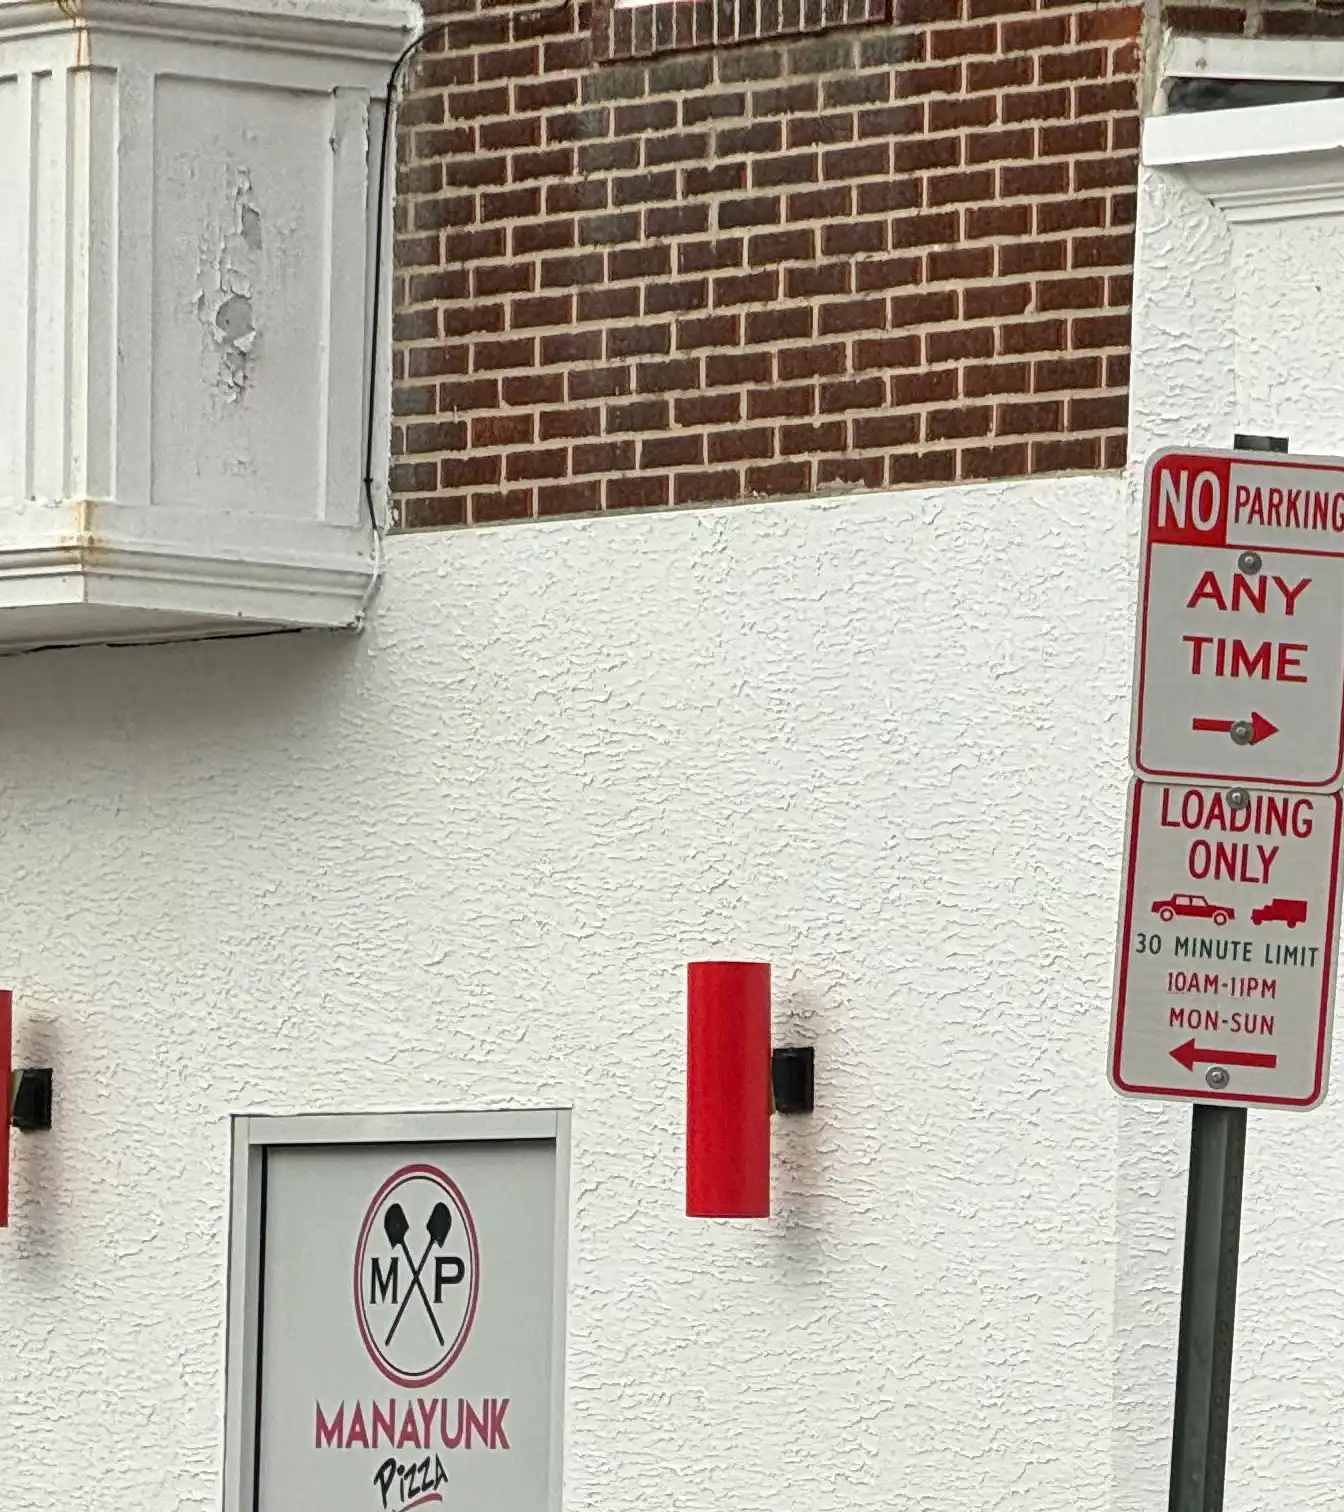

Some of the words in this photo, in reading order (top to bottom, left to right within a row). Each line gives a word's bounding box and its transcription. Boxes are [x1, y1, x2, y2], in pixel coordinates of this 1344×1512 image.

[1158, 468, 1221, 532] NO
[1187, 570, 1312, 617] ANY
[1183, 635, 1309, 684] TIME
[1160, 786, 1314, 839] LOADING
[1189, 840, 1279, 885] ONLY
[1136, 932, 1162, 955] 30
[1174, 935, 1252, 963] MINUTE
[1264, 942, 1320, 968] LIMIT
[1167, 971, 1277, 999] 10AM-11PM
[1168, 1007, 1275, 1036] MON-SUN
[370, 1257, 399, 1304] M
[434, 1256, 465, 1304] P
[315, 1397, 511, 1450] MANAYUNK
